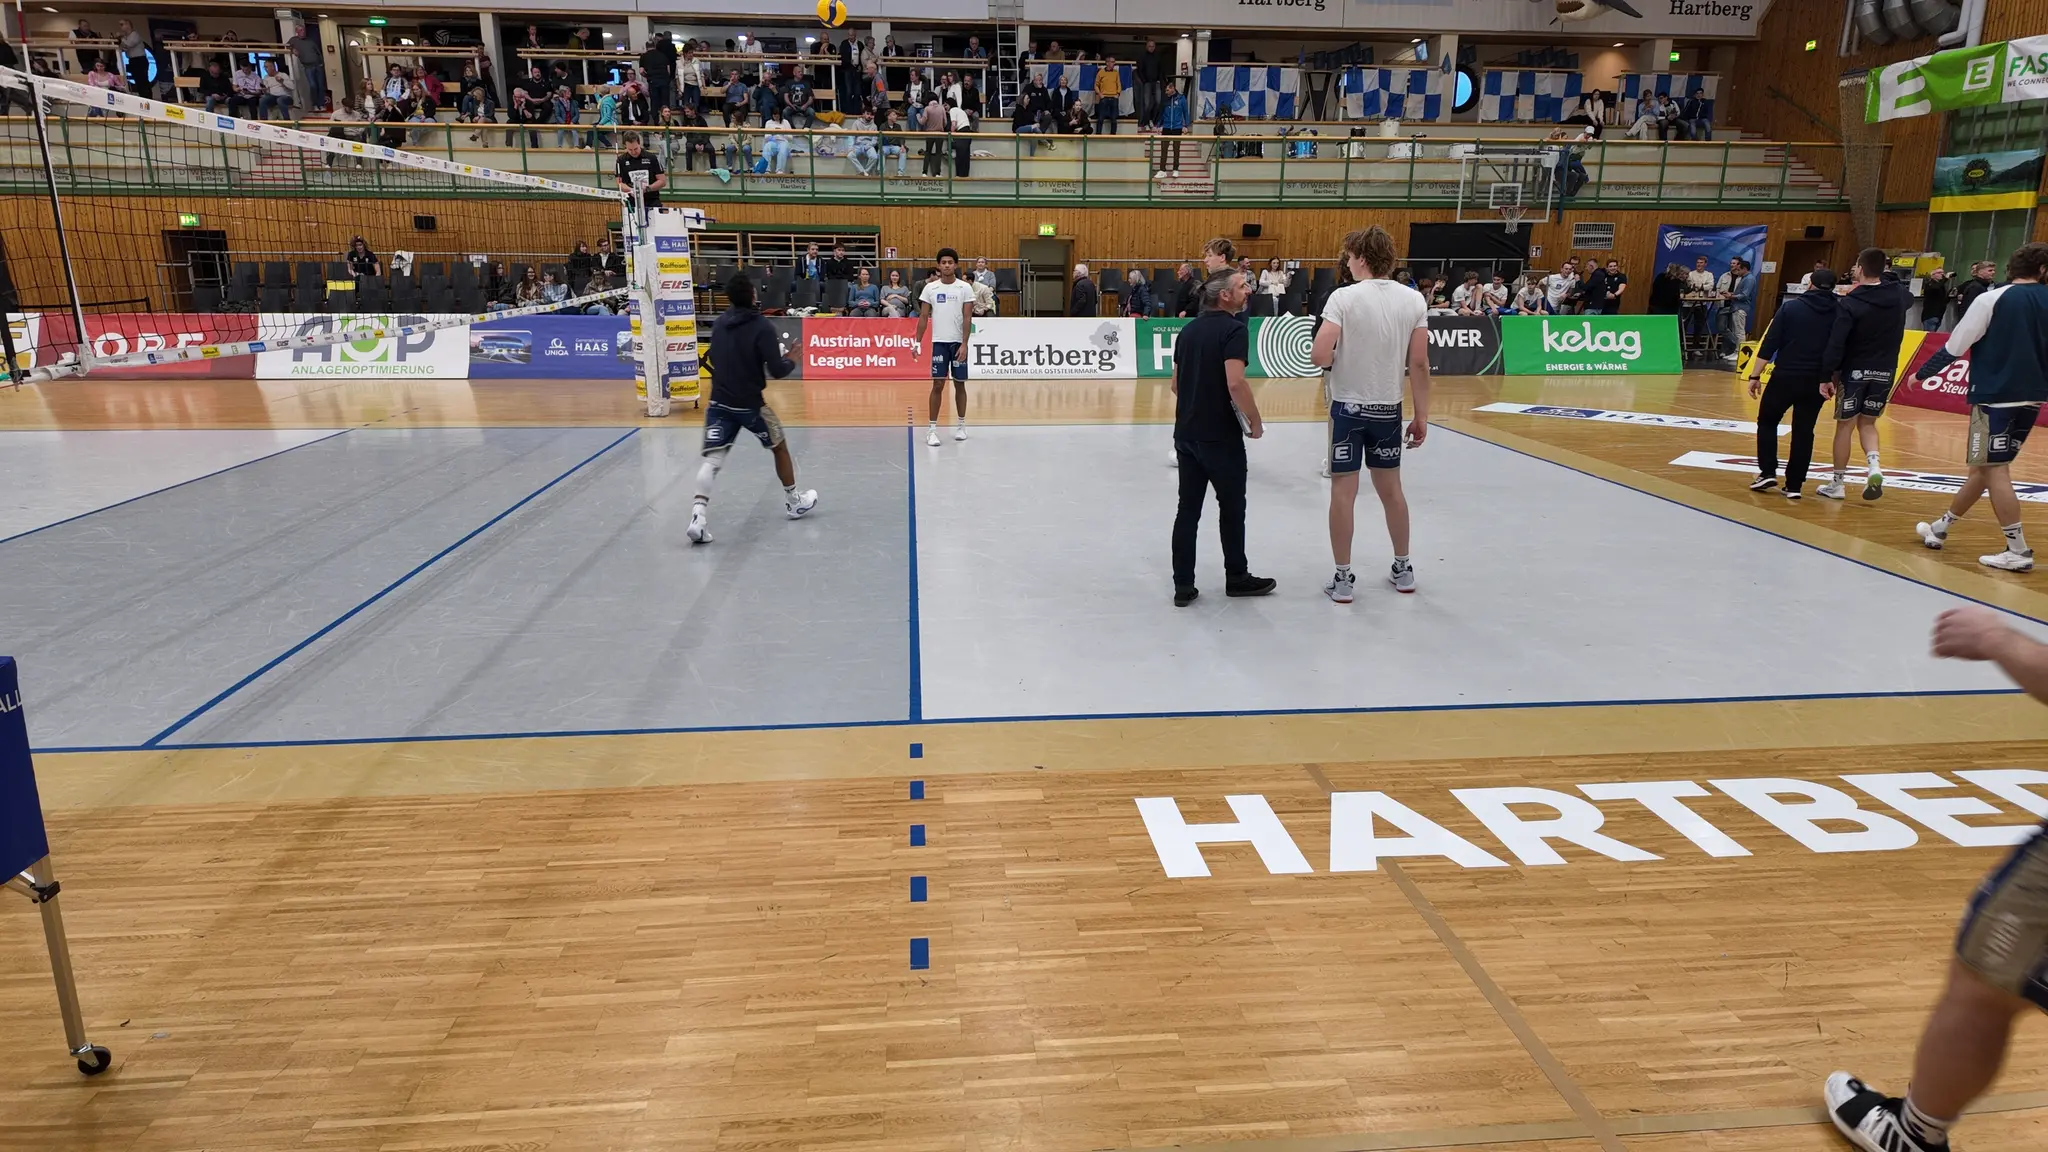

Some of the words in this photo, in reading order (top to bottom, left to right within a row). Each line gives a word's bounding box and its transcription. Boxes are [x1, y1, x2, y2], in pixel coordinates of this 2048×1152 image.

[1669, 0, 1753, 21] Hartberg
[2008, 52, 2048, 78] FAS
[2007, 80, 2017, 88] WE
[2018, 77, 2048, 86] CONNE
[809, 335, 871, 348] Austrian
[874, 335, 918, 351] Volley
[1543, 319, 1642, 360] kelag
[575, 343, 609, 352] HAAS
[809, 354, 862, 370] League
[865, 354, 896, 366] Men
[973, 344, 1118, 371] Hartberg
[291, 365, 435, 375] ANLAGENOPTIMIERUNG
[1546, 363, 1584, 371] ENERGIE
[1586, 363, 1593, 371] &
[1594, 362, 1628, 371] WÄRME
[1939, 382, 1969, 395] Steu
[1843, 400, 1854, 410] E
[706, 429, 721, 439] E
[1993, 437, 2007, 450] E
[1334, 446, 1349, 460] E
